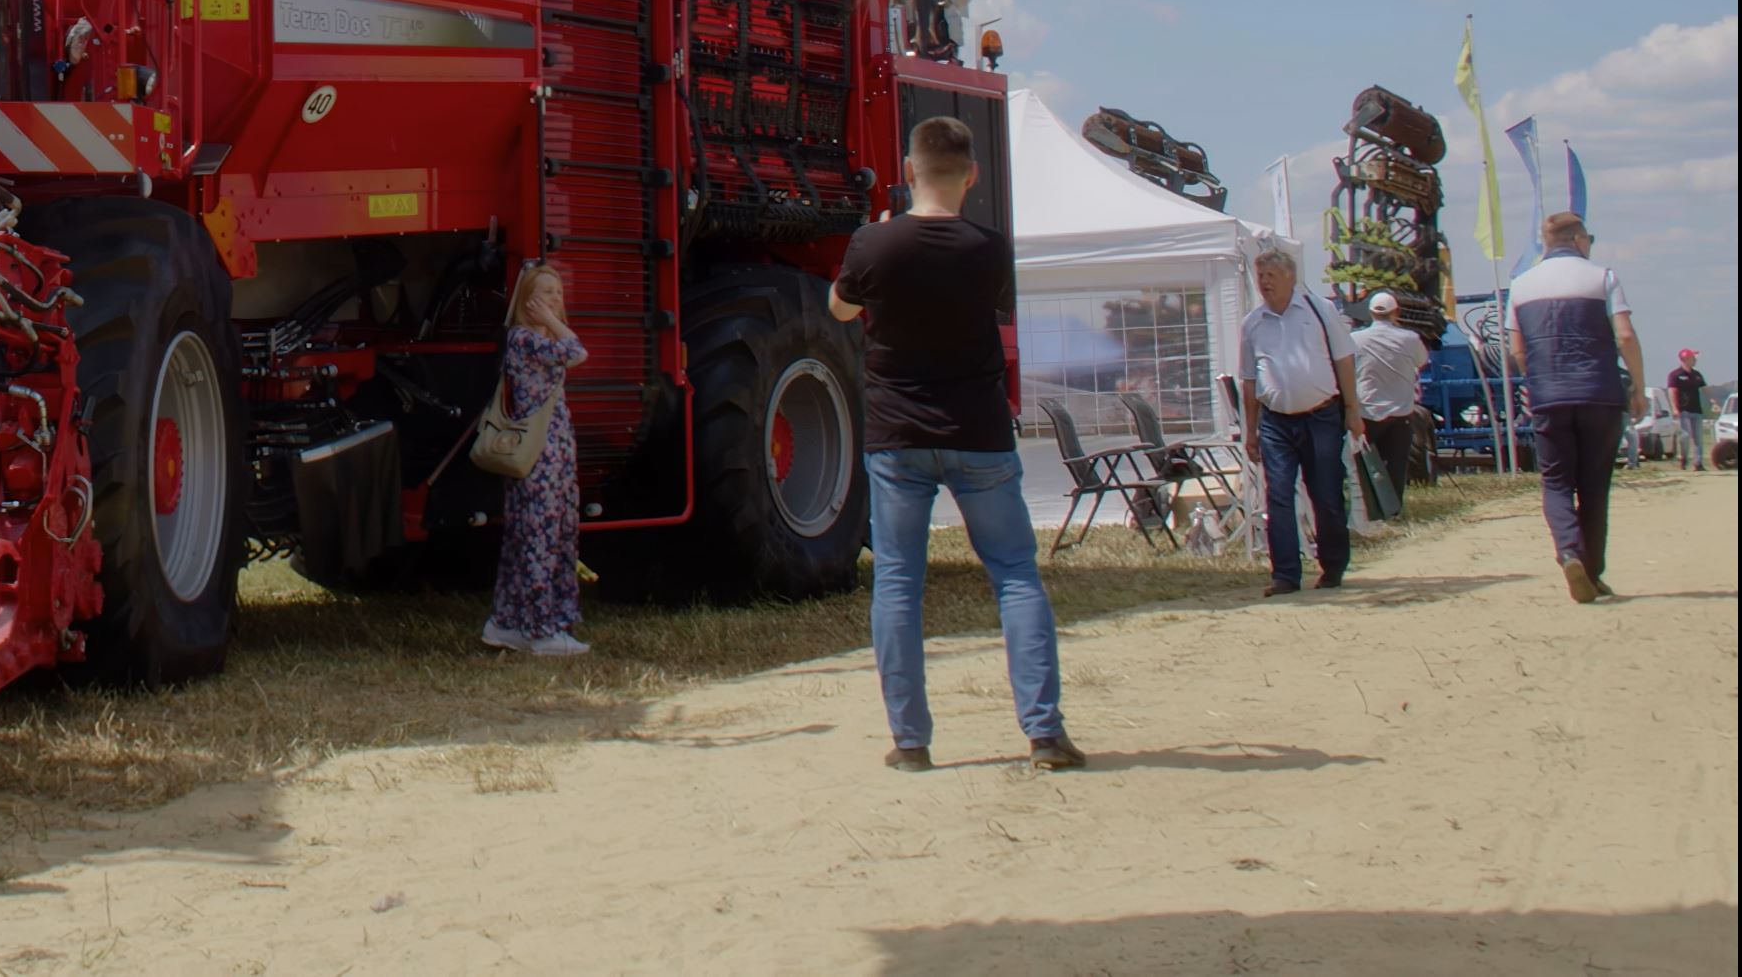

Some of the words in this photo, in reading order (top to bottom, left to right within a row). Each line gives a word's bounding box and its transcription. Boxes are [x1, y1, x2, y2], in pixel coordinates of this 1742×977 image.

[279, 1, 330, 34] Terra
[335, 9, 371, 38] Dos
[308, 94, 332, 115] 40
